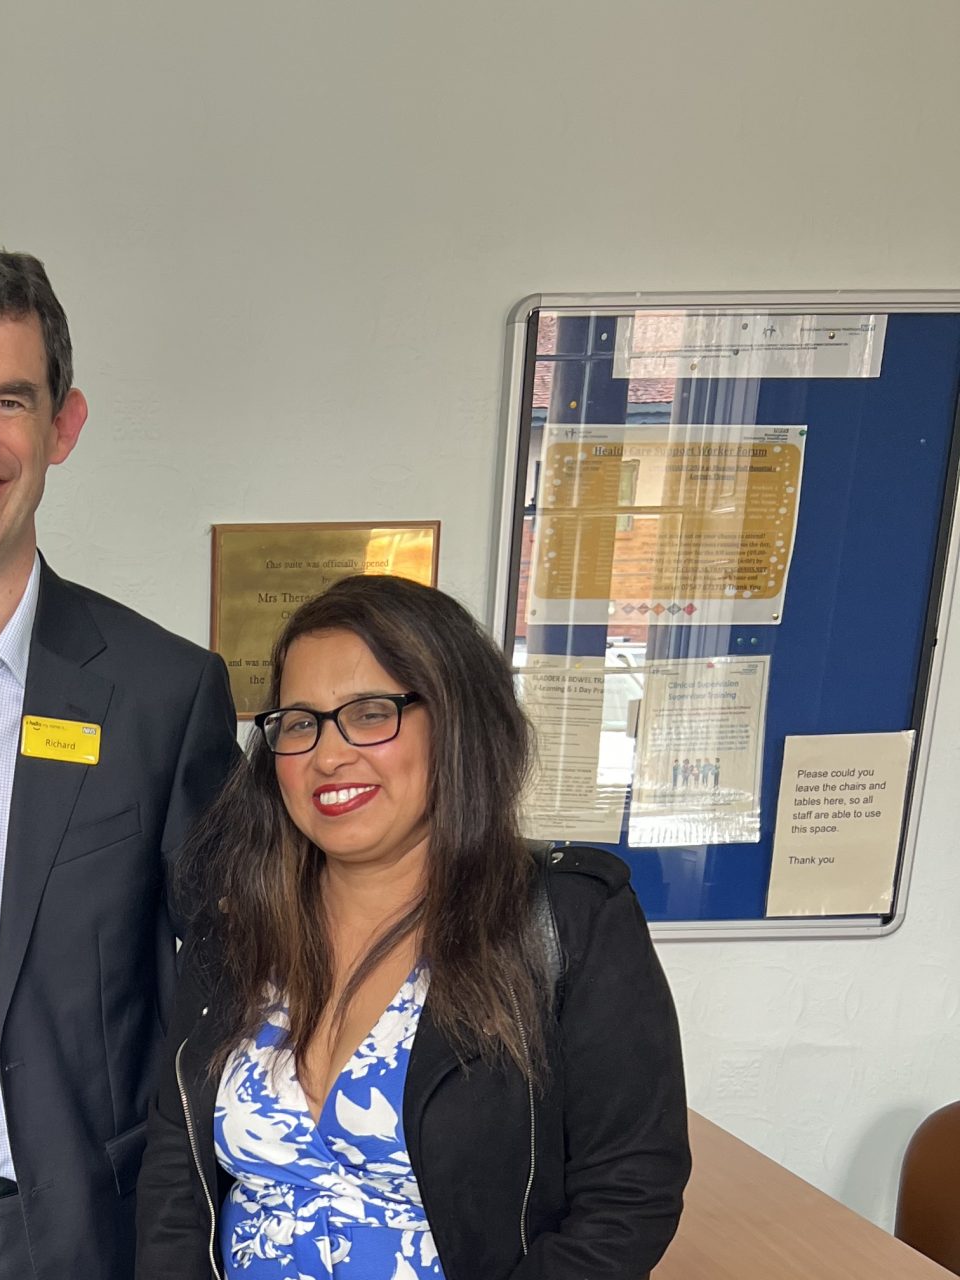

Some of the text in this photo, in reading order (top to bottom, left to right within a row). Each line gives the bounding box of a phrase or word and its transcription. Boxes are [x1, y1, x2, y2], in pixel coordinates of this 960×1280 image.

[322, 559, 358, 570] officially
[361, 559, 389, 570] opened
[257, 593, 278, 603] Mrs
[249, 675, 265, 685] the
[667, 680, 696, 689] Clinical
[45, 739, 76, 750] Richard
[797, 768, 875, 779] Please could you
[795, 781, 887, 792] leave the chairs and
[794, 797, 821, 806] tables
[823, 796, 847, 806] here,
[862, 795, 874, 804] all
[792, 811, 813, 820] staff
[831, 810, 851, 818] able
[853, 810, 862, 818] to
[864, 810, 882, 818] use
[791, 825, 840, 835] this space.
[788, 856, 835, 866] Thank you
